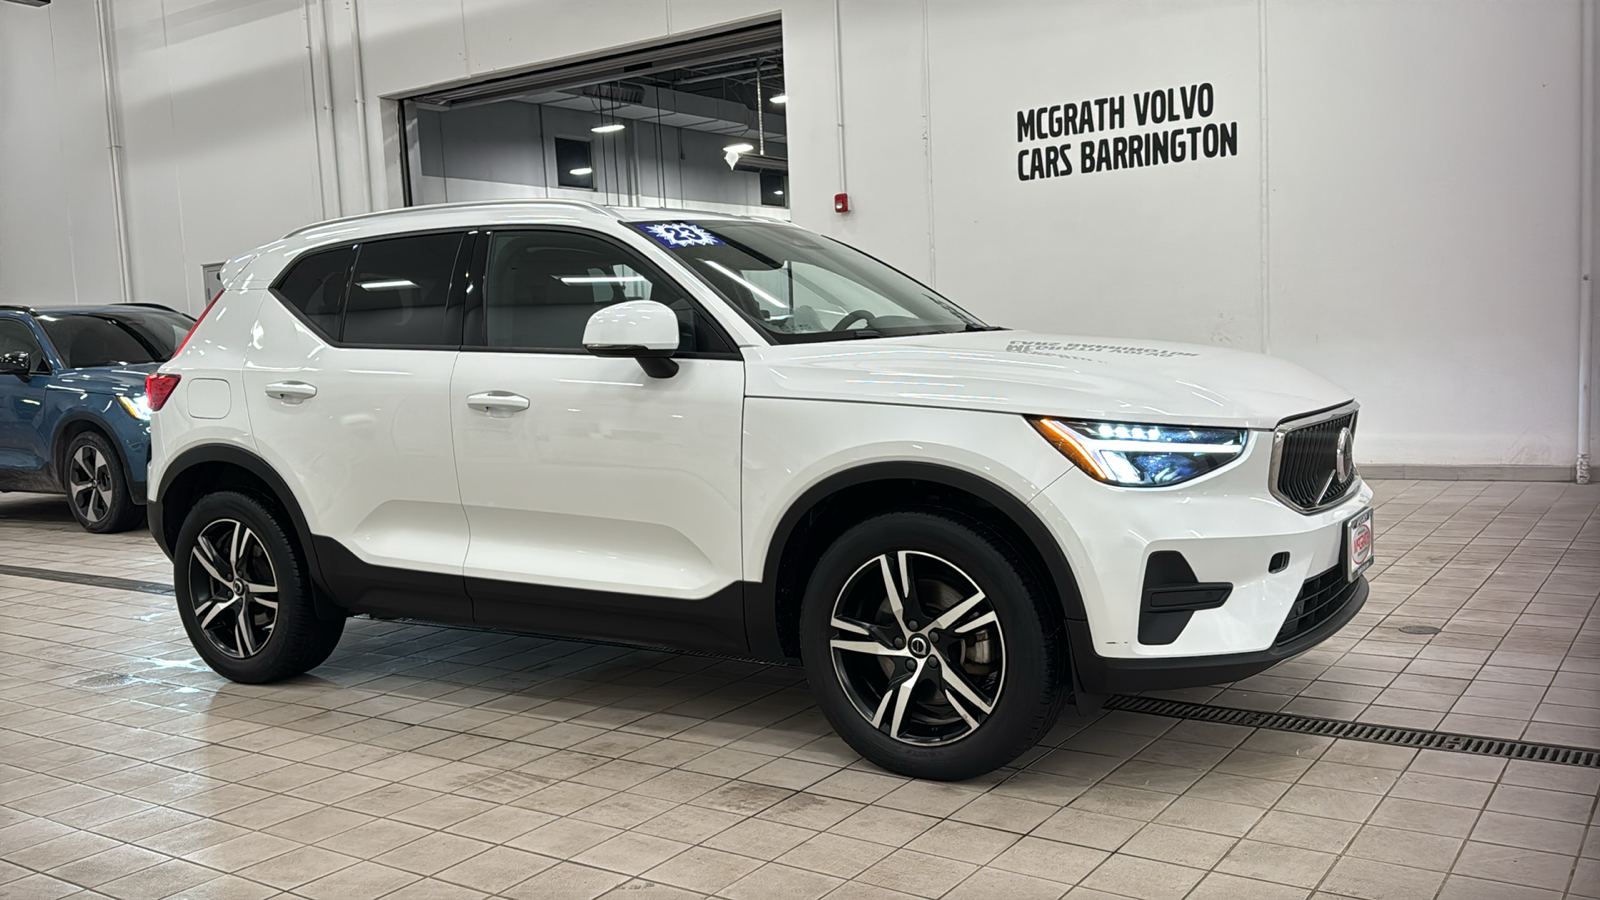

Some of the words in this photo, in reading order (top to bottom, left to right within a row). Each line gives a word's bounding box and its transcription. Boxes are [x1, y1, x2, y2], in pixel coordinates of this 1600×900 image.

[1017, 95, 1125, 143] MCGRATH
[1133, 82, 1214, 126] VOLVO
[1017, 143, 1073, 181] CARS
[1080, 121, 1238, 174] BARRINGTON
[663, 227, 703, 241] 23
